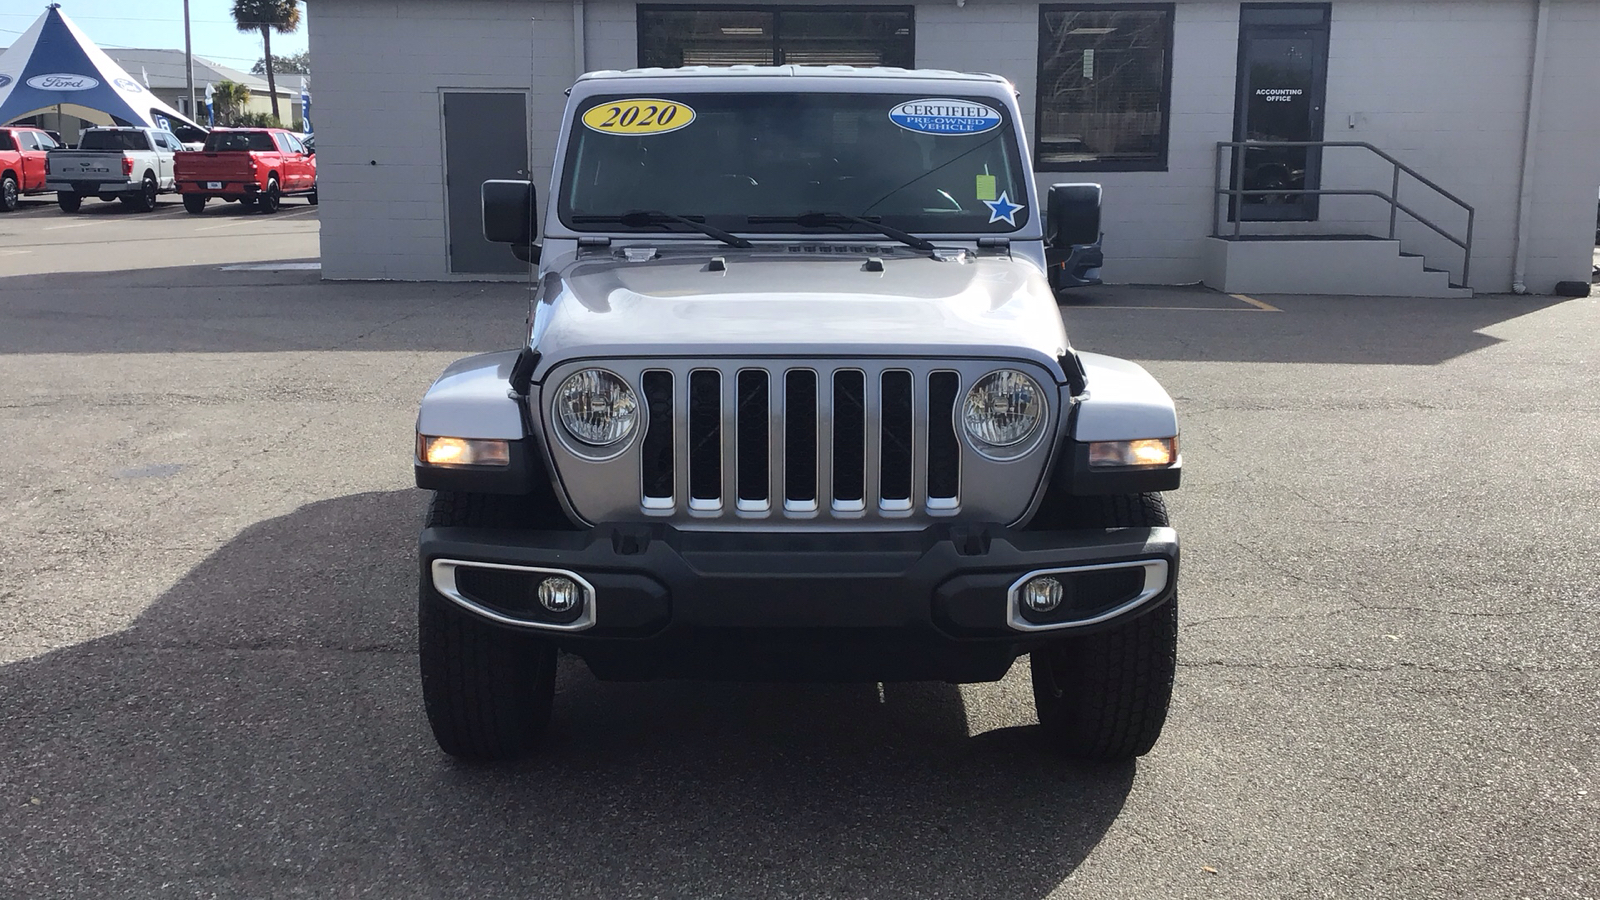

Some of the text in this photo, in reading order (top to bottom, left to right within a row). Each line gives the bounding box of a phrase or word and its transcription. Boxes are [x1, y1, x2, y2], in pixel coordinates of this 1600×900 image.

[42, 76, 83, 88] Ford
[599, 105, 677, 127] 2020
[902, 105, 988, 117] CERTIFIED
[906, 117, 985, 125] PRE-OWNED
[919, 123, 974, 131] VEHICLE
